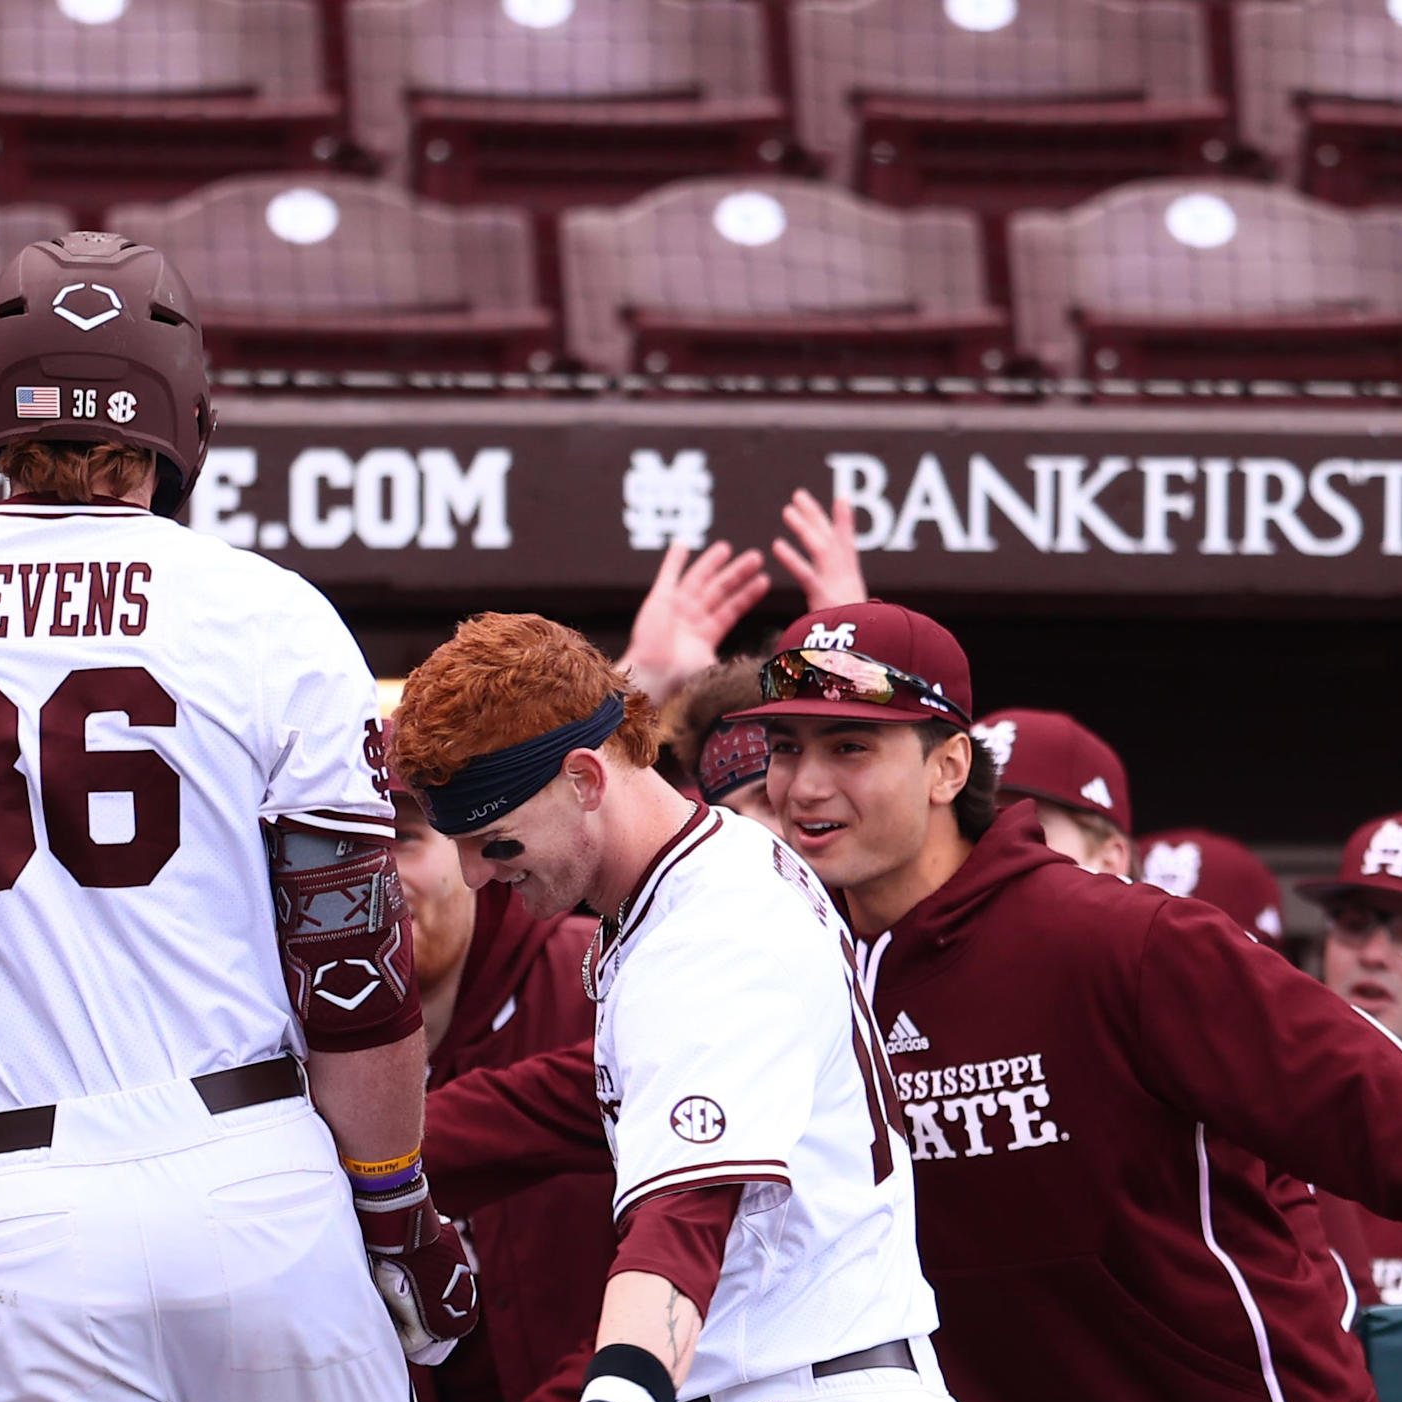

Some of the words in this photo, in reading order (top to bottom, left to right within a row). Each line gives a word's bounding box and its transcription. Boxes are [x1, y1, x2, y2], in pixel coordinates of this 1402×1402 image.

[72, 389, 97, 418] 36
[106, 390, 138, 424] SEC
[886, 1036, 930, 1055] adidas
[894, 1053, 1046, 1101] SSISSIPPI
[670, 1095, 726, 1144] SEC
